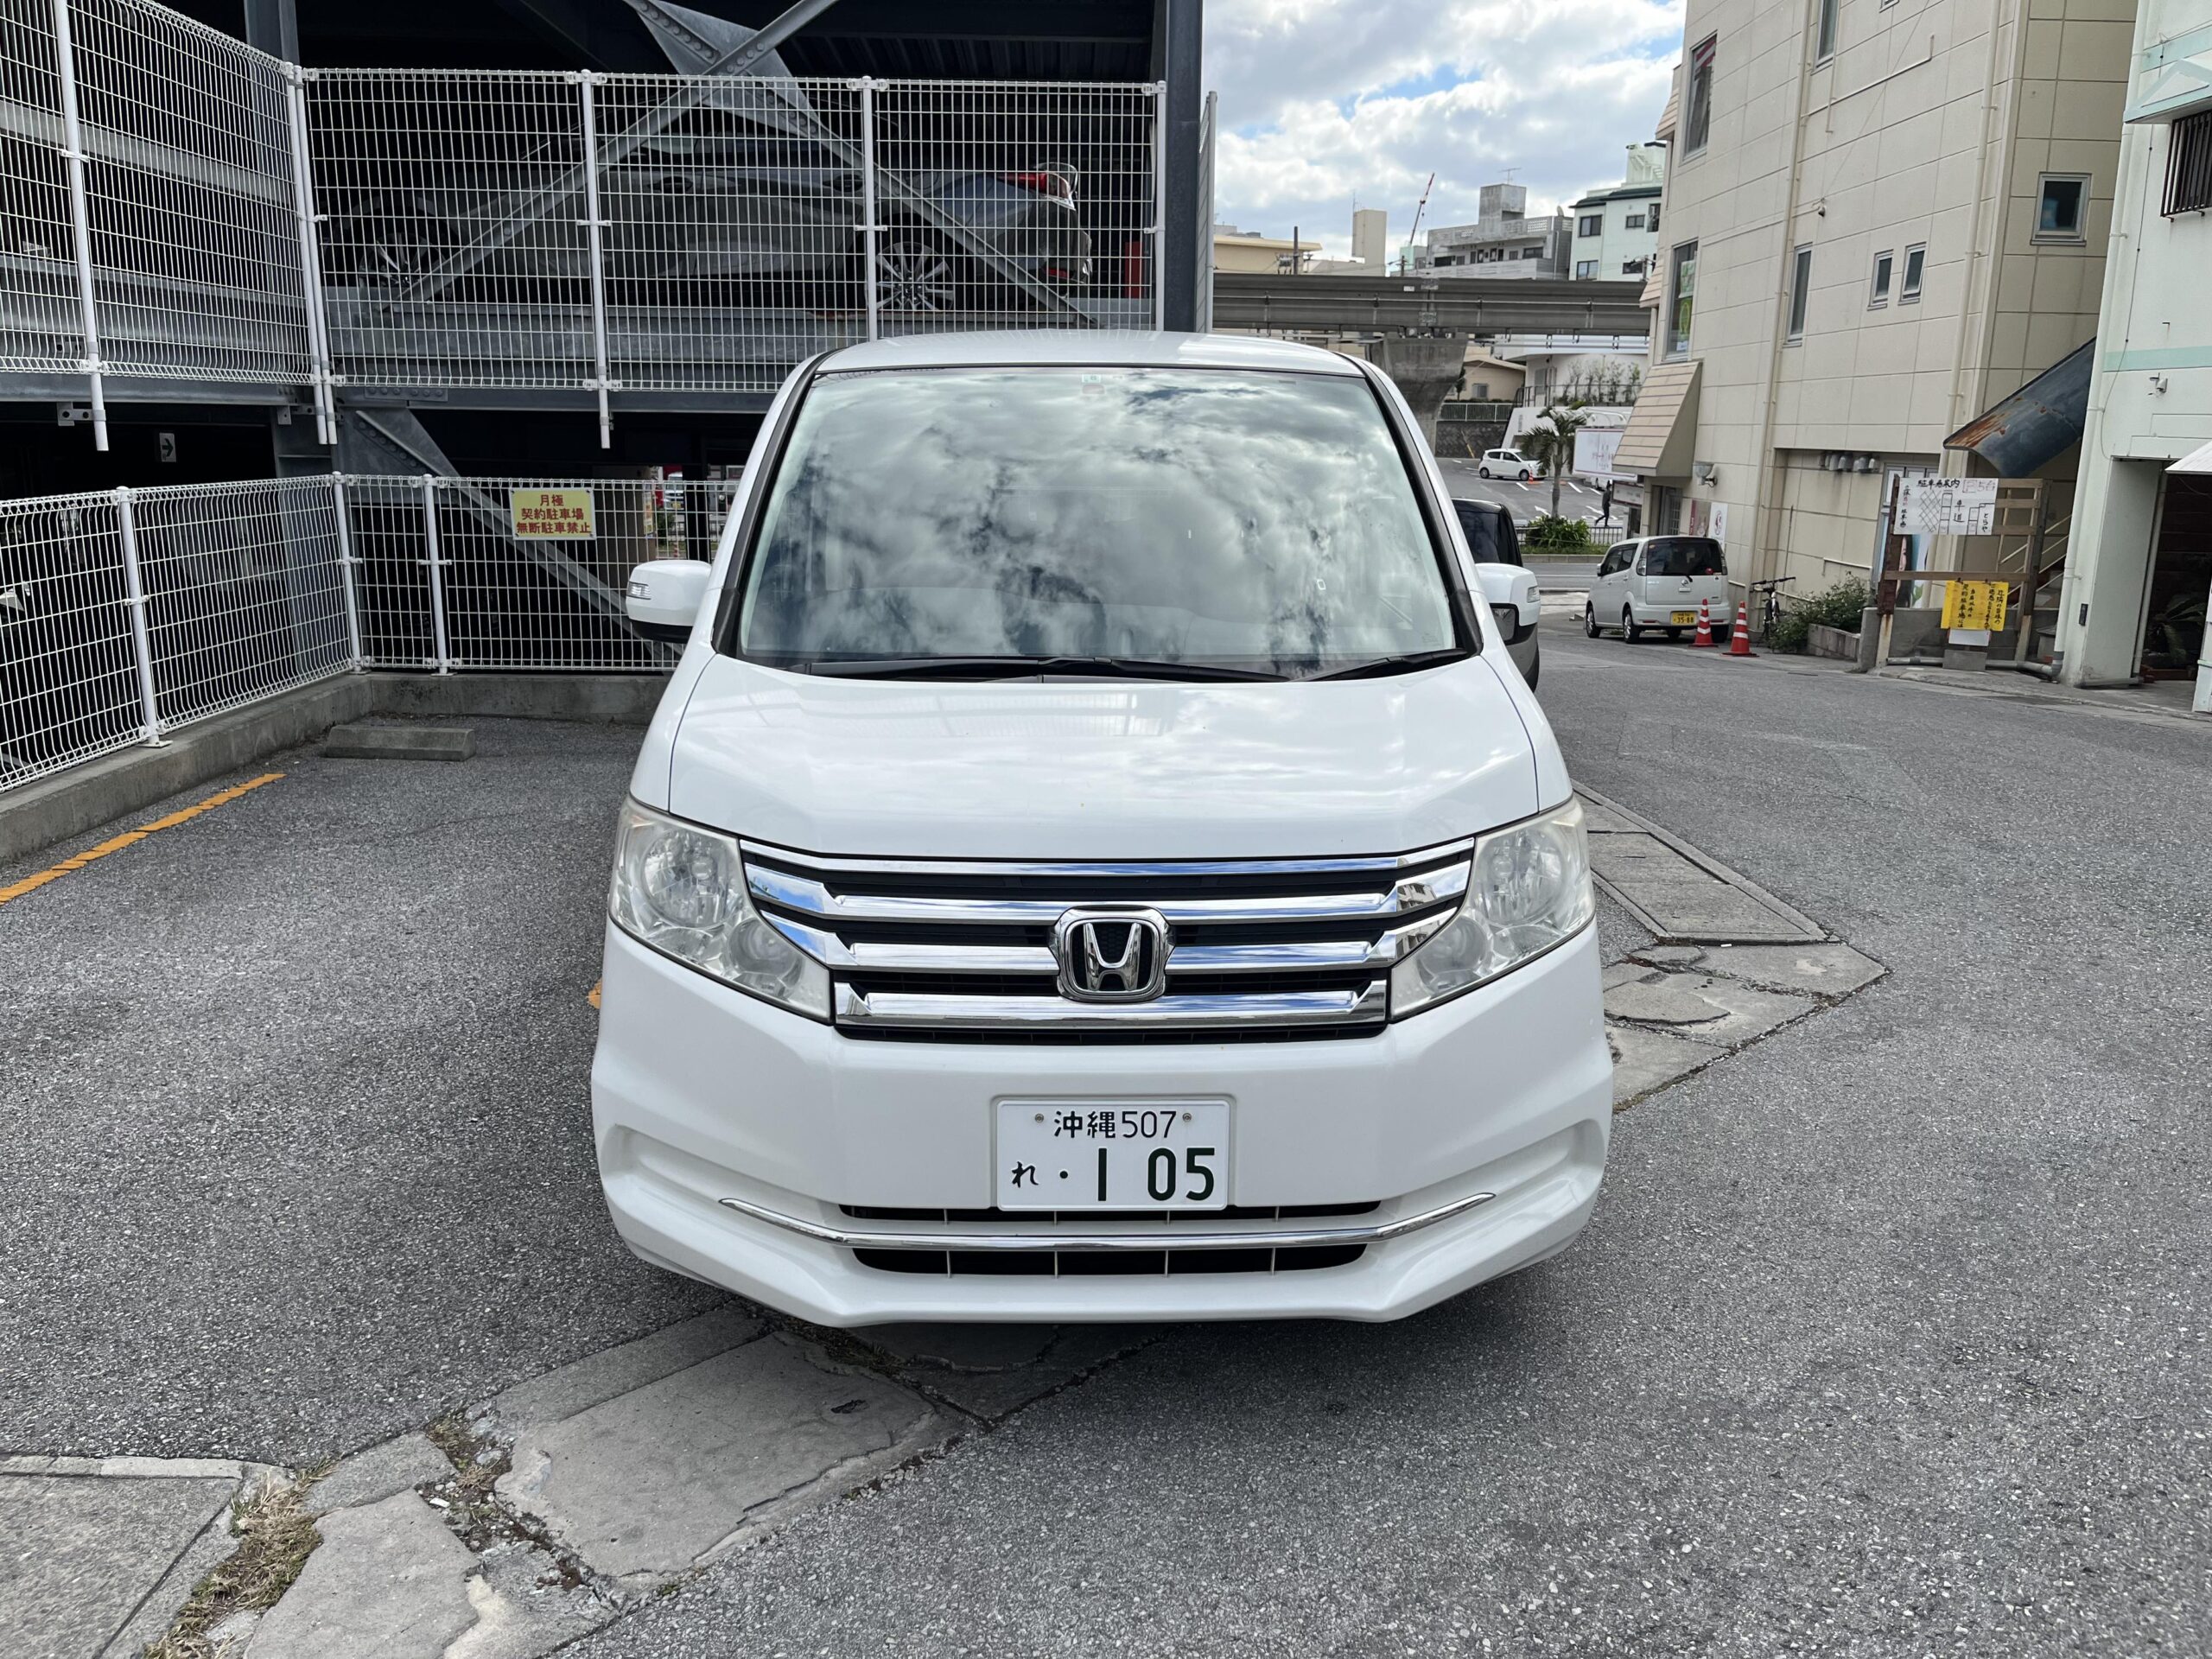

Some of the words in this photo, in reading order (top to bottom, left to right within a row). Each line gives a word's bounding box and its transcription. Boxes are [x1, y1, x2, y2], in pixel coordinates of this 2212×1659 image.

[540, 494, 564, 506] 月極
[521, 508, 584, 520] 契約駐車場
[516, 522, 592, 534] 無断駐車禁止
